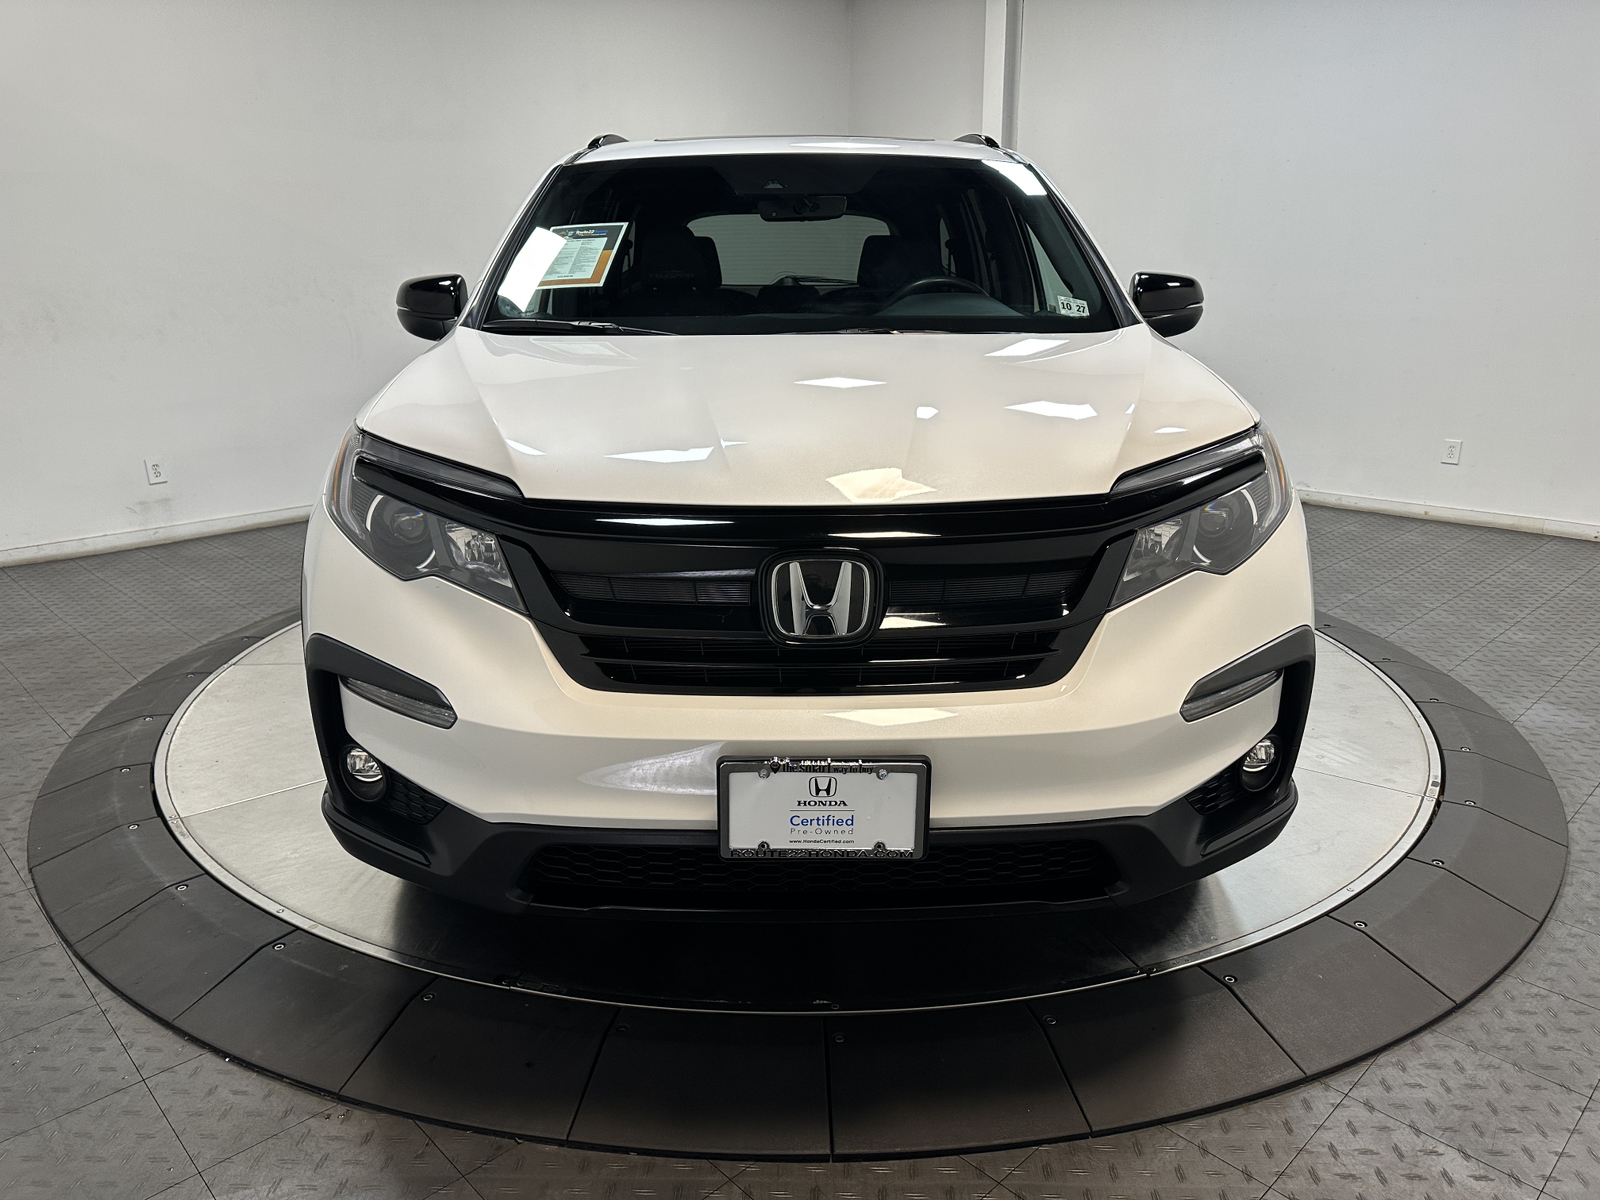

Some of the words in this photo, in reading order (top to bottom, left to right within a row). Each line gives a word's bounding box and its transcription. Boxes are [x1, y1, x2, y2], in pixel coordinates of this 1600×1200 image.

[1061, 302, 1072, 311] 10
[1076, 305, 1086, 313] 27
[782, 763, 798, 773] the
[799, 763, 831, 773] smart
[833, 766, 849, 774] way
[790, 814, 854, 827] Certified
[730, 849, 914, 858] ROUTE22HONDA.COM
